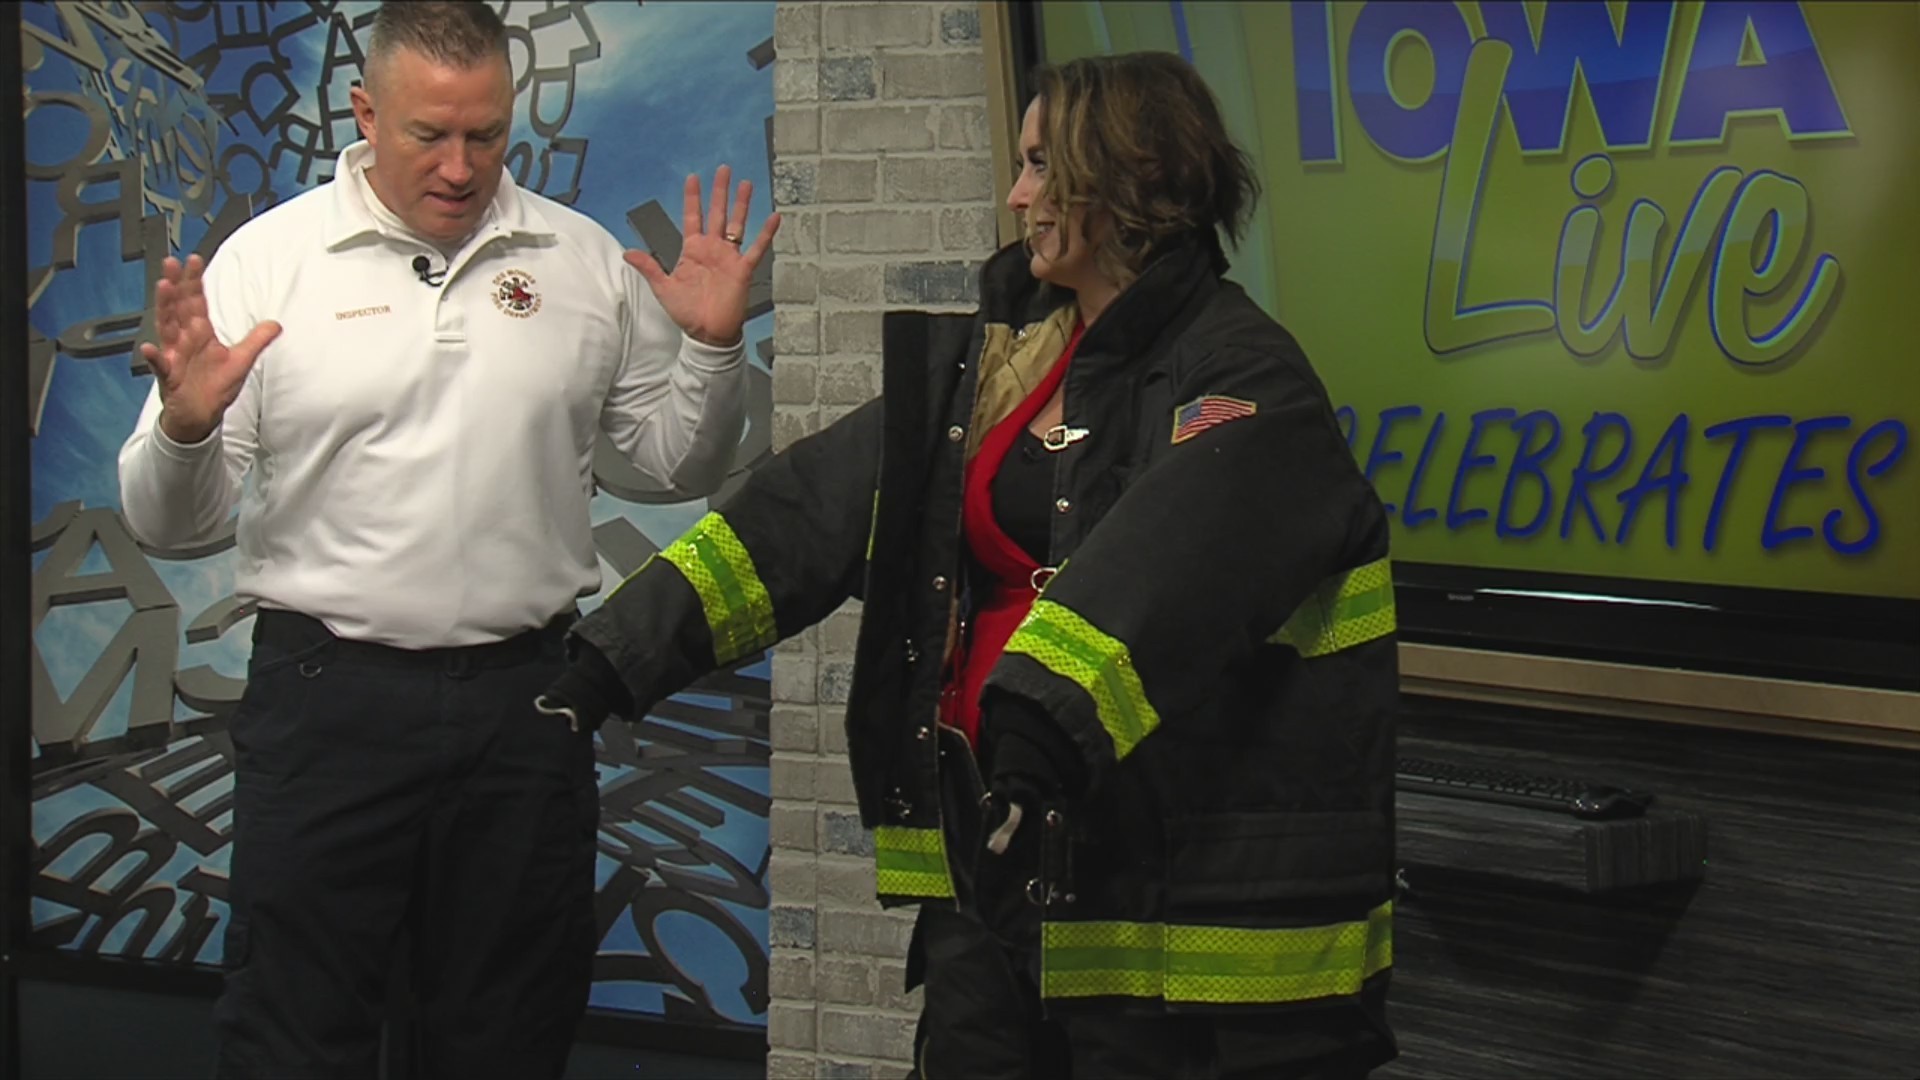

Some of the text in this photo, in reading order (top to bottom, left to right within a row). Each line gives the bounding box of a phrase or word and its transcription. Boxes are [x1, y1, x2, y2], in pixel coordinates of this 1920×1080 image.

[1291, 0, 1855, 164] IOWA
[1423, 37, 1841, 366] Live
[335, 304, 392, 321] INSPECTOR
